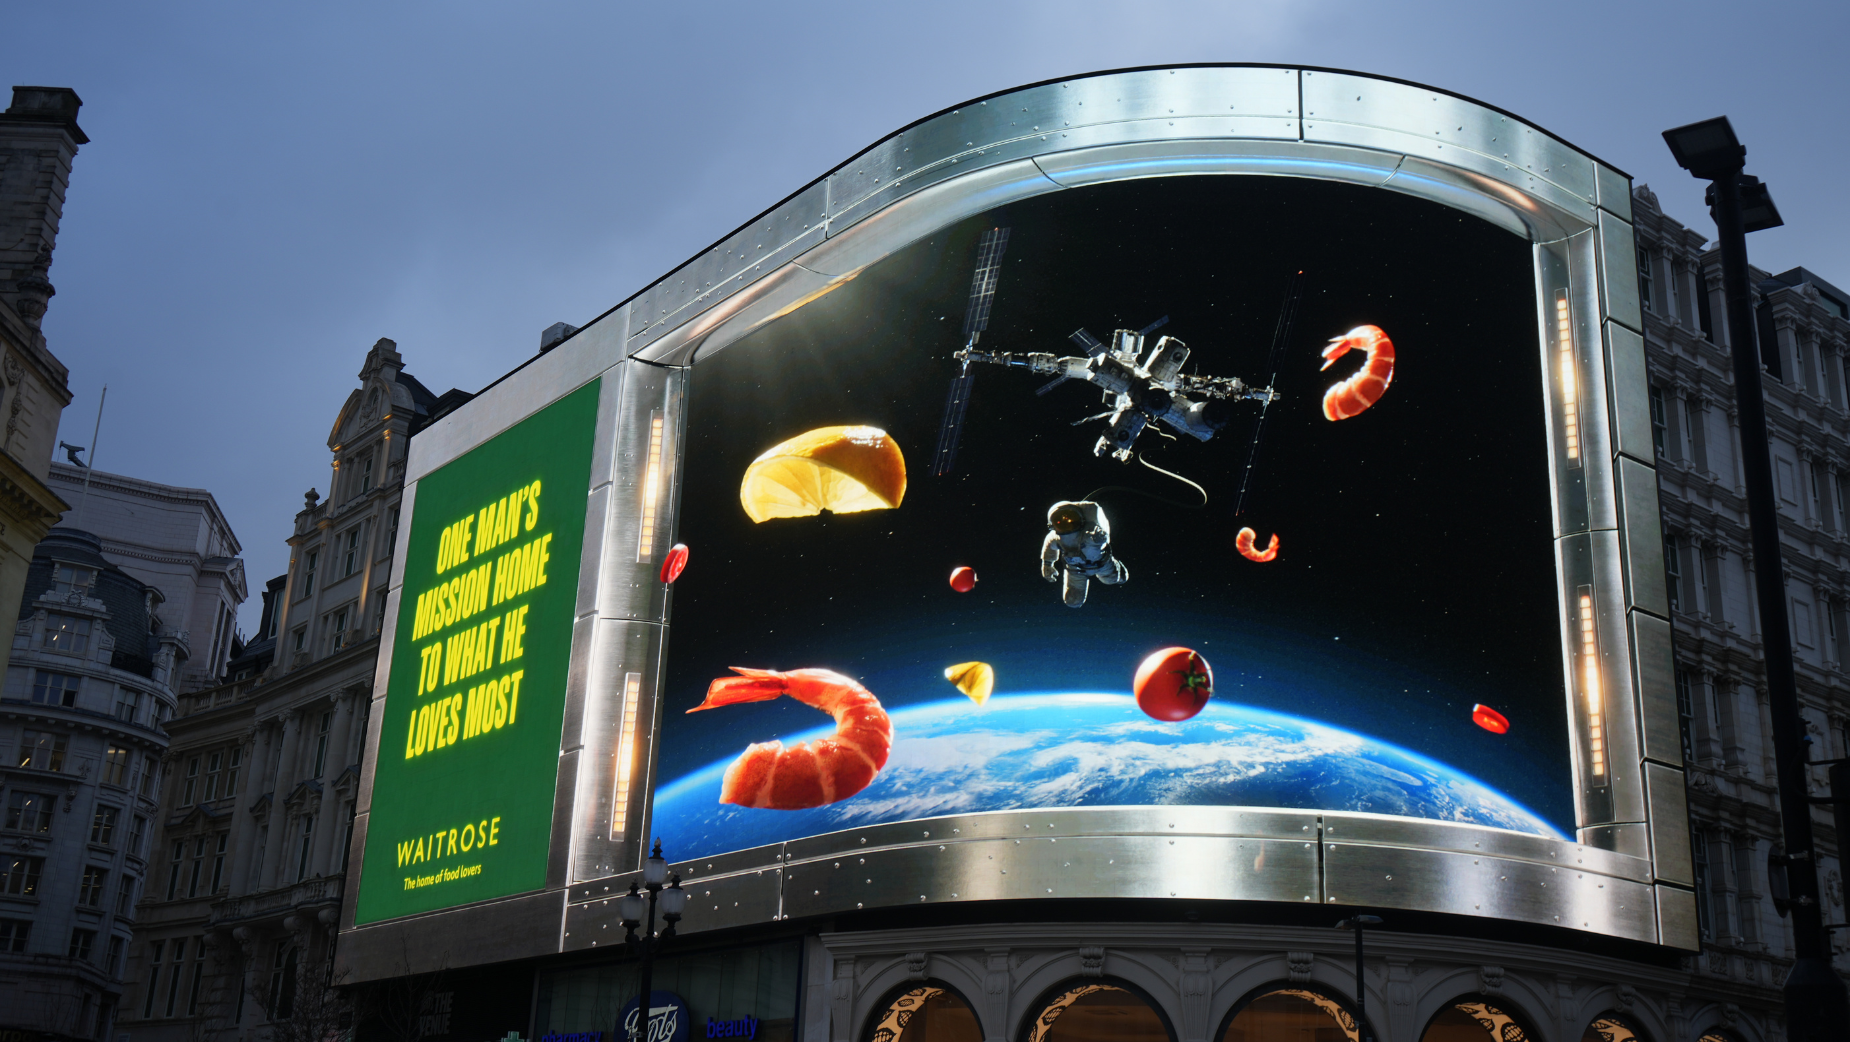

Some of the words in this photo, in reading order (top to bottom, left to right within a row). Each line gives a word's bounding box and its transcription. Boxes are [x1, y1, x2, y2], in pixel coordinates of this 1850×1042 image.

[436, 513, 475, 575] ONE
[474, 479, 542, 557] MAN’S
[411, 561, 492, 642] MISSION
[492, 532, 553, 607] HOME
[417, 641, 443, 696] TO
[443, 616, 501, 686] WHAT
[499, 604, 529, 664] HE
[405, 692, 463, 760] LOVES
[462, 669, 524, 740] MOST
[397, 816, 502, 868] WAITROSE
[404, 877, 416, 891] The
[416, 875, 435, 887] home
[435, 869, 444, 884] of
[444, 865, 461, 882] food
[460, 864, 482, 878] lovers
[419, 1012, 453, 1037] VENUE
[624, 1003, 679, 1042] Bots
[706, 1014, 759, 1041] beauty
